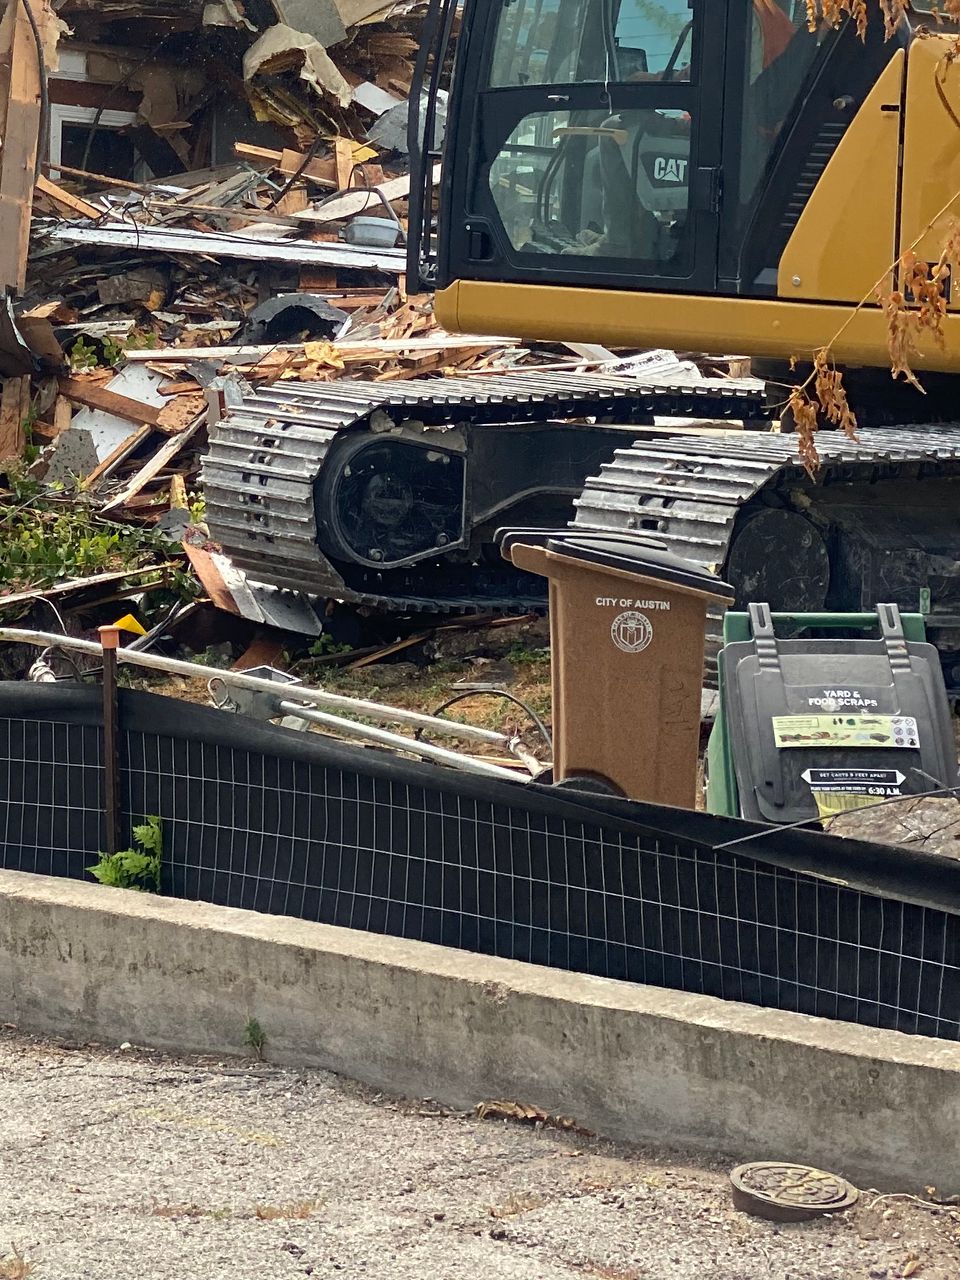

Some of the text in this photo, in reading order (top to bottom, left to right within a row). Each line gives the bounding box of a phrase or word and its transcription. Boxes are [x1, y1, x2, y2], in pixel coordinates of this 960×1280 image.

[654, 157, 688, 182] CAT
[595, 596, 671, 610] CITY OF AUSTIN
[823, 690, 861, 698] YARD &
[808, 697, 878, 707] FOOD SCRAPS
[868, 786, 885, 795] 6:30
[886, 787, 902, 796] A.M.
